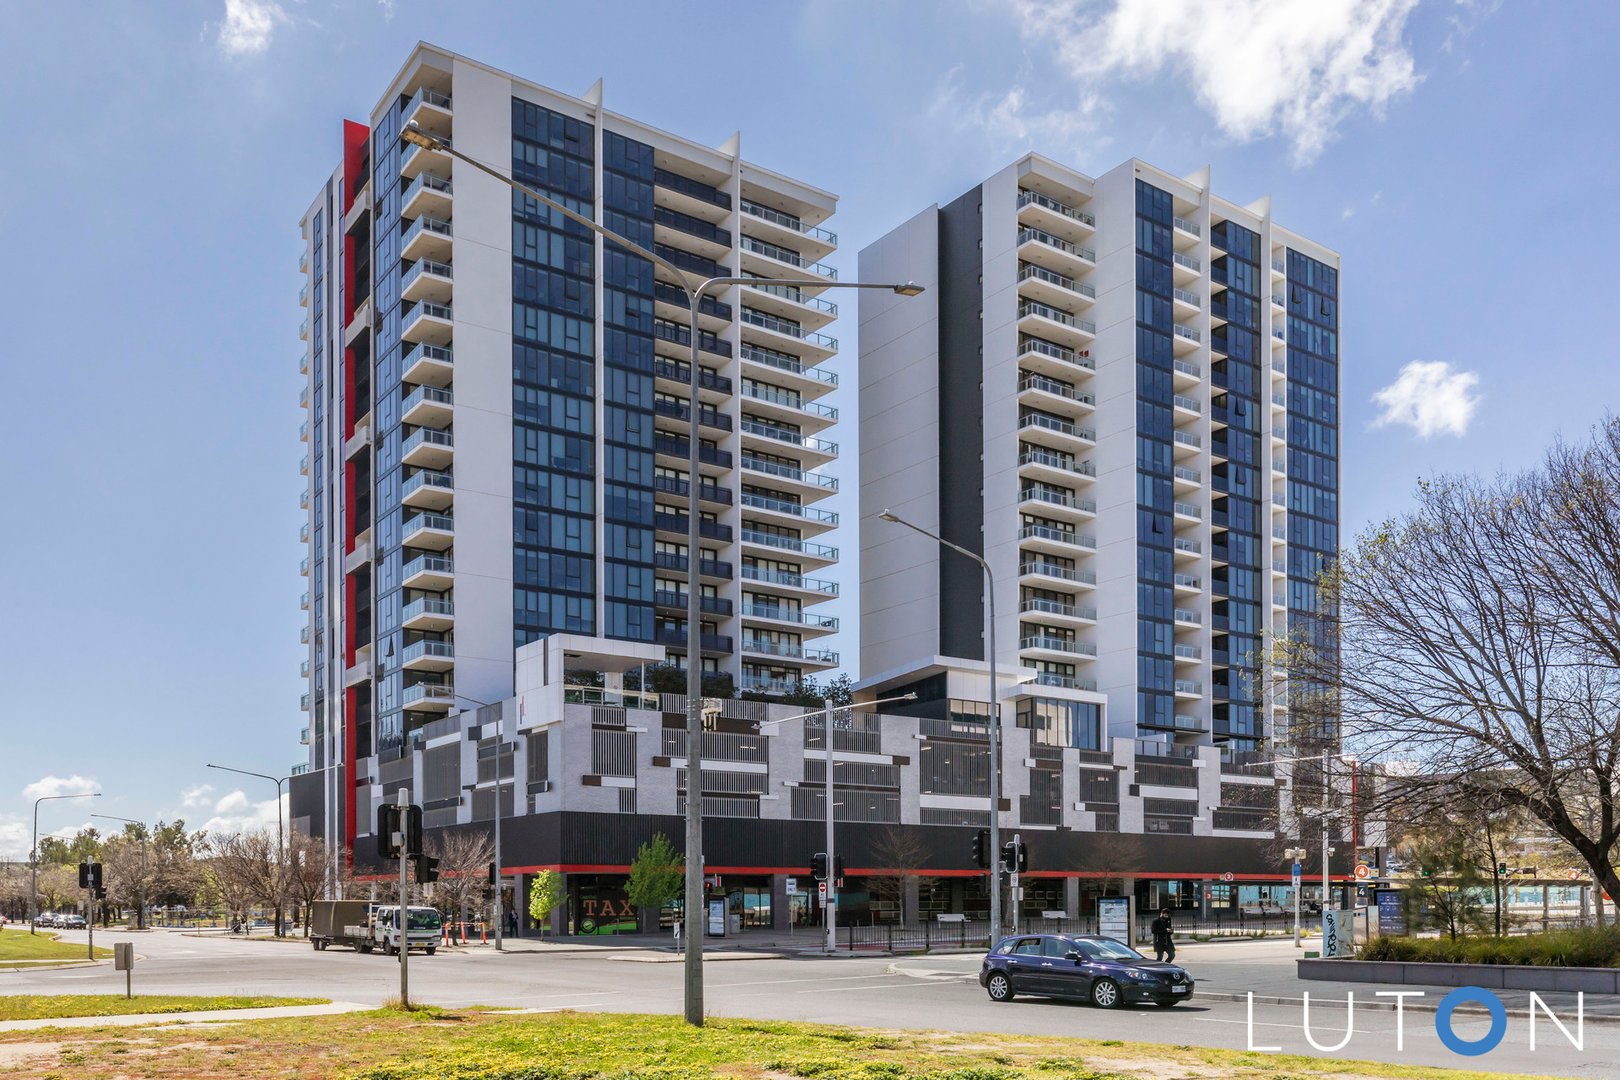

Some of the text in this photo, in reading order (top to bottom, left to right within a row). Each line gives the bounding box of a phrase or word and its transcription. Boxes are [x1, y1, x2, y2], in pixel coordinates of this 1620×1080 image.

[1358, 867, 1366, 876] 4
[1358, 887, 1366, 896] 4
[583, 899, 635, 916] TAX
